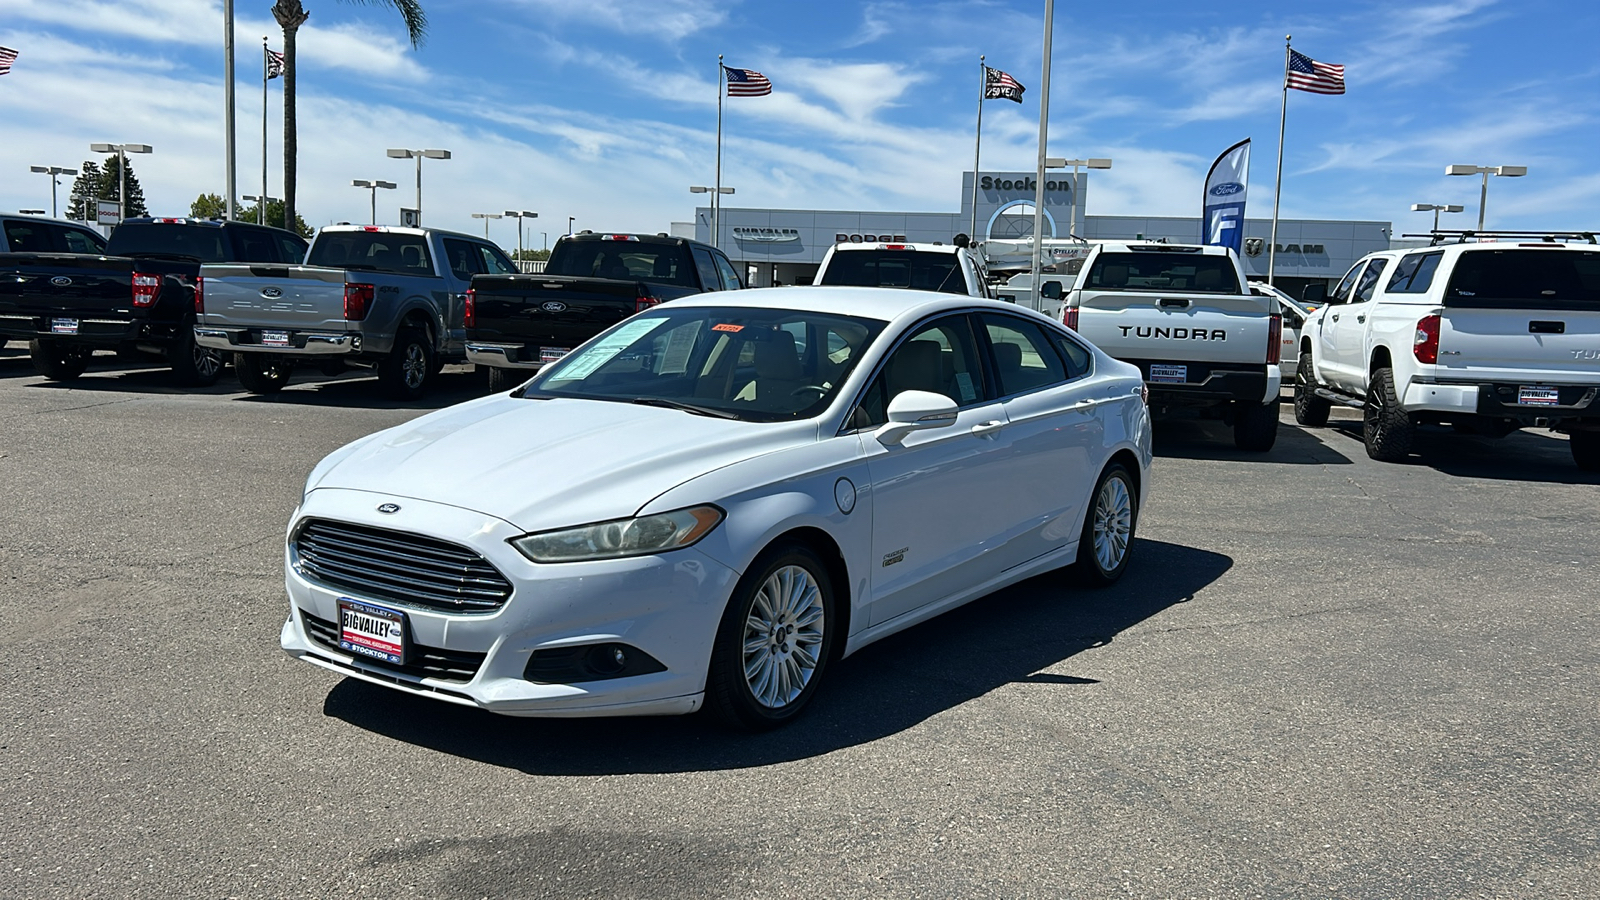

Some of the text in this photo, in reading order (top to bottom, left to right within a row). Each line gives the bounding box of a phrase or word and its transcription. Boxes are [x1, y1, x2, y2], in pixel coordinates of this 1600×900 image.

[981, 176, 1069, 191] Stockon
[1216, 184, 1238, 195] Ford
[835, 233, 907, 243] DODGE
[1266, 244, 1324, 254] RAM
[1118, 326, 1227, 341] TUNDRA
[1521, 390, 1551, 398] BIGVALLEY
[364, 606, 388, 617] VALLEY
[343, 612, 390, 638] BIGVALLEY
[351, 645, 388, 660] STOCKTON
